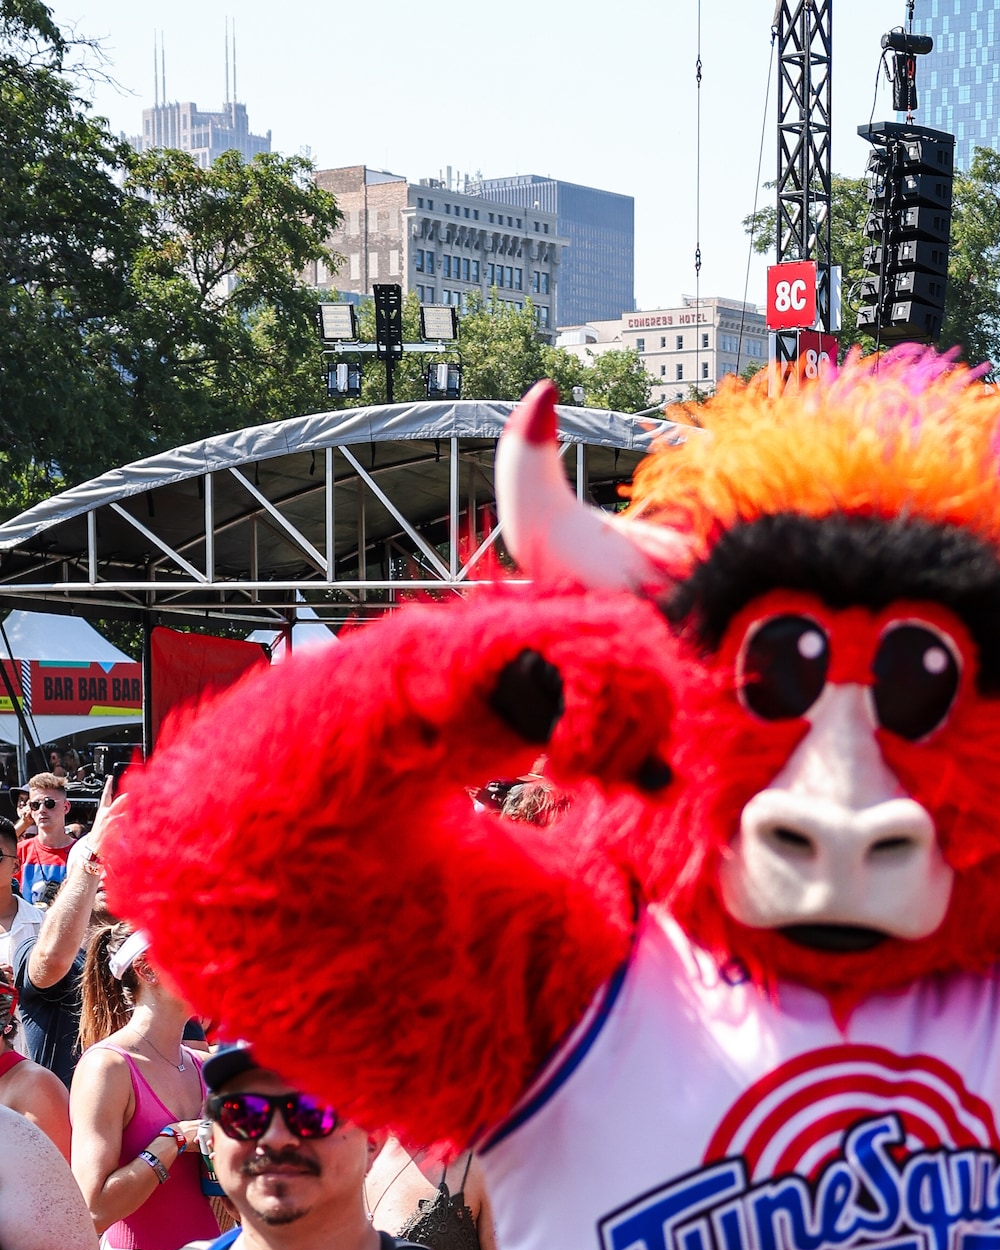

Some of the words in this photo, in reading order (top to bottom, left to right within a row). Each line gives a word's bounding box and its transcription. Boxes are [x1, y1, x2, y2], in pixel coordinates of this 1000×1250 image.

[775, 279, 807, 312] 8C
[628, 315, 673, 328] CONGRESS
[679, 313, 708, 324] HOTEL
[43, 676, 74, 701] BAR
[78, 677, 108, 701] BAR
[111, 677, 141, 702] BAR
